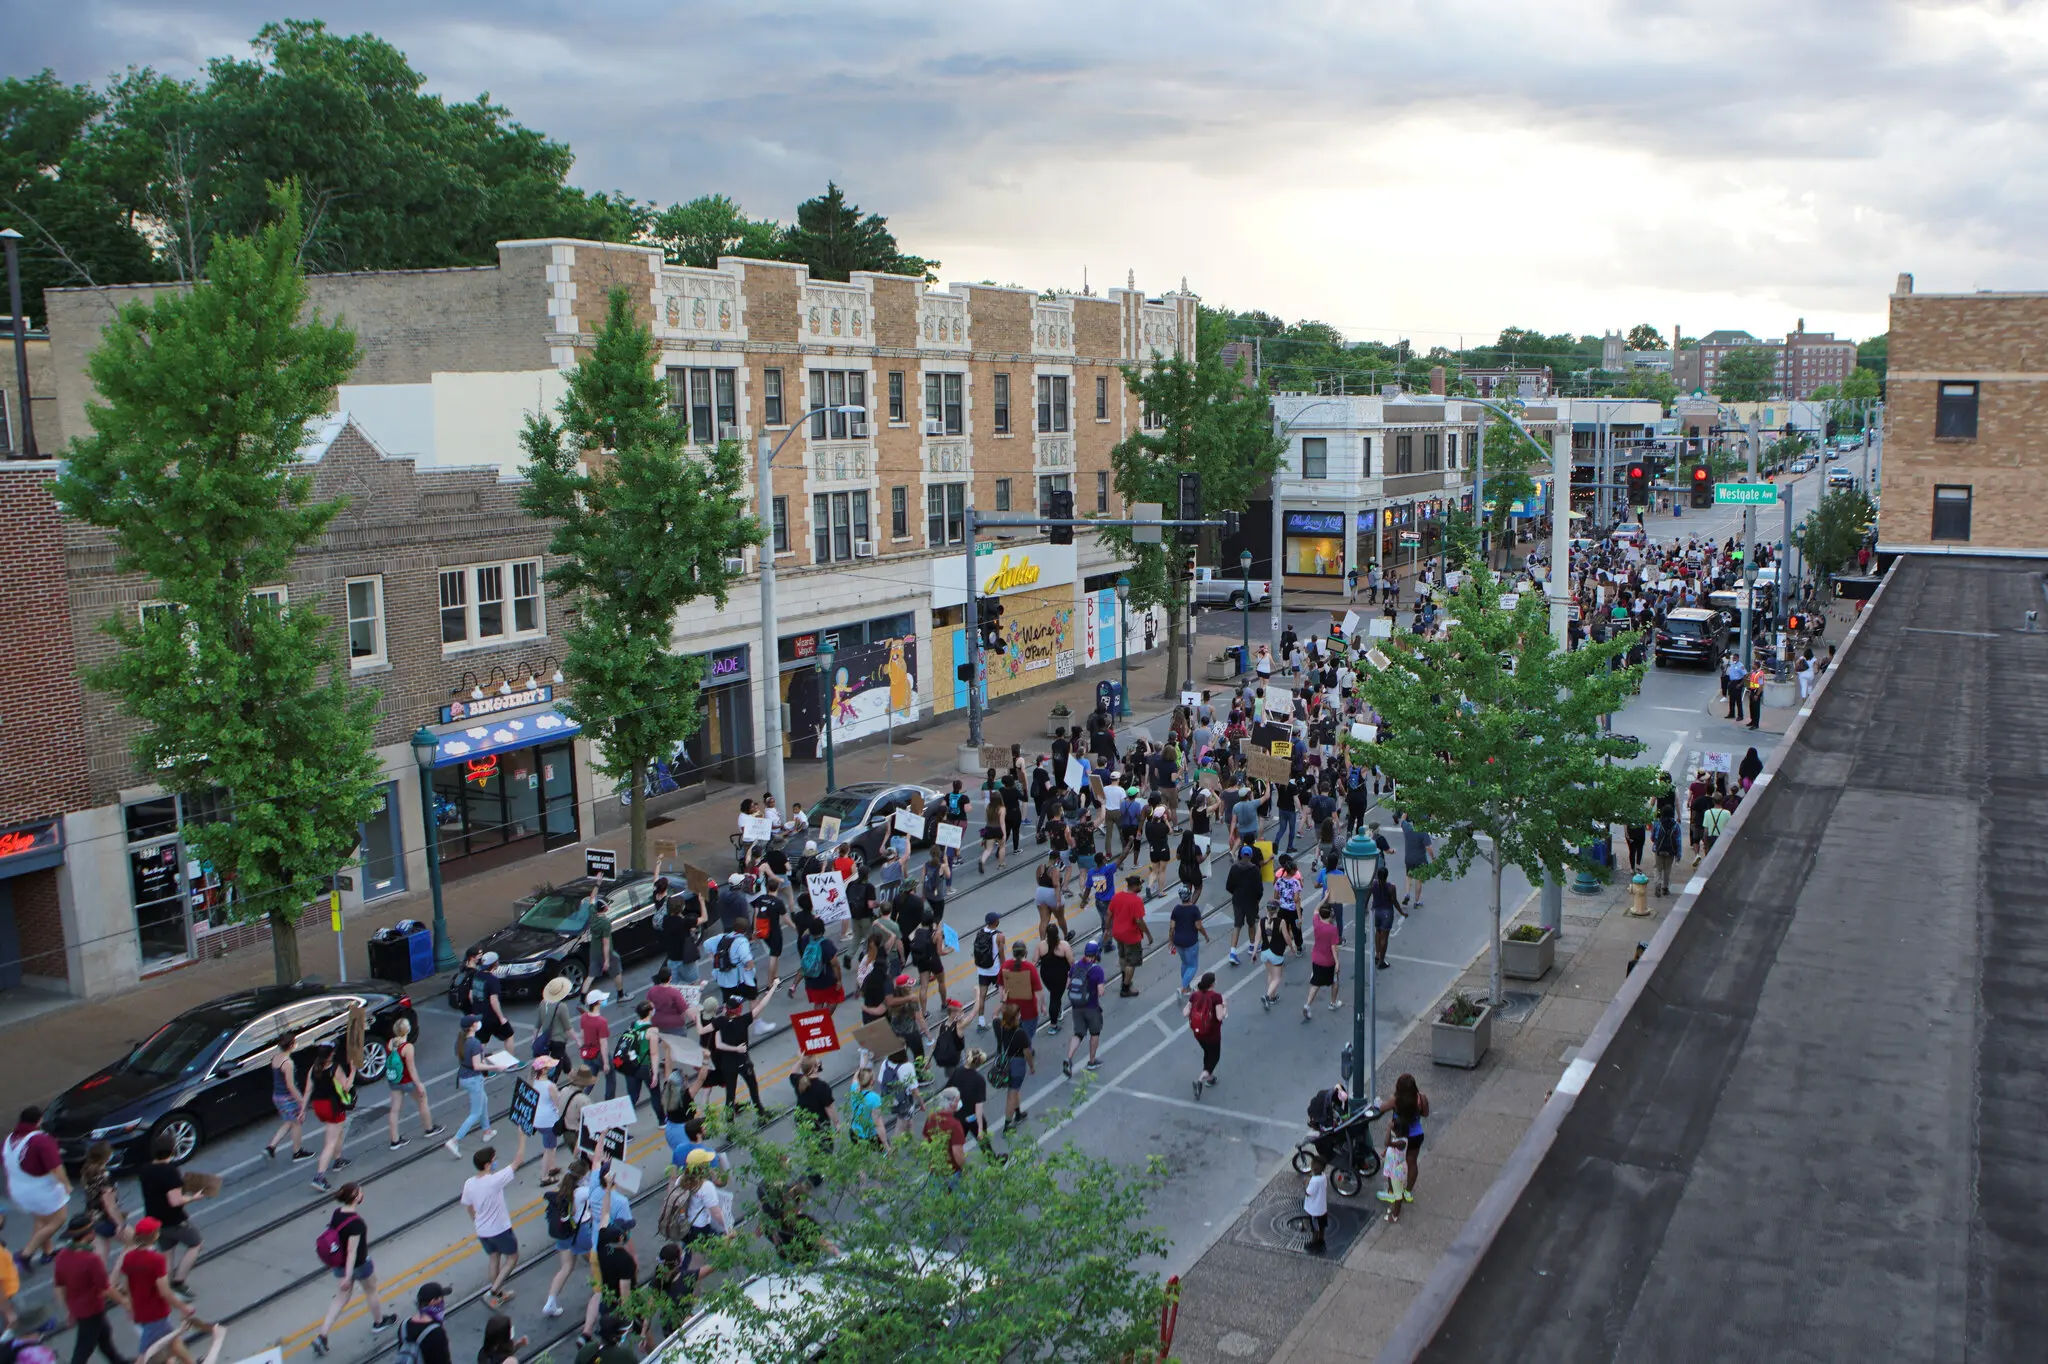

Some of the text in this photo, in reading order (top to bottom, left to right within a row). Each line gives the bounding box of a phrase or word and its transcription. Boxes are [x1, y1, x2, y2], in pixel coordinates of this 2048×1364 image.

[1719, 487, 1774, 504] Westgate Ave
[1290, 514, 1323, 530] Blueberry
[1324, 515, 1343, 531] Hill
[975, 542, 992, 551] DELMAR
[1022, 624, 1055, 645] We're
[809, 875, 836, 885] VIVA
[799, 1015, 824, 1026] TRUMP
[805, 1036, 832, 1050] HATE
[519, 1082, 538, 1107] BLACK
